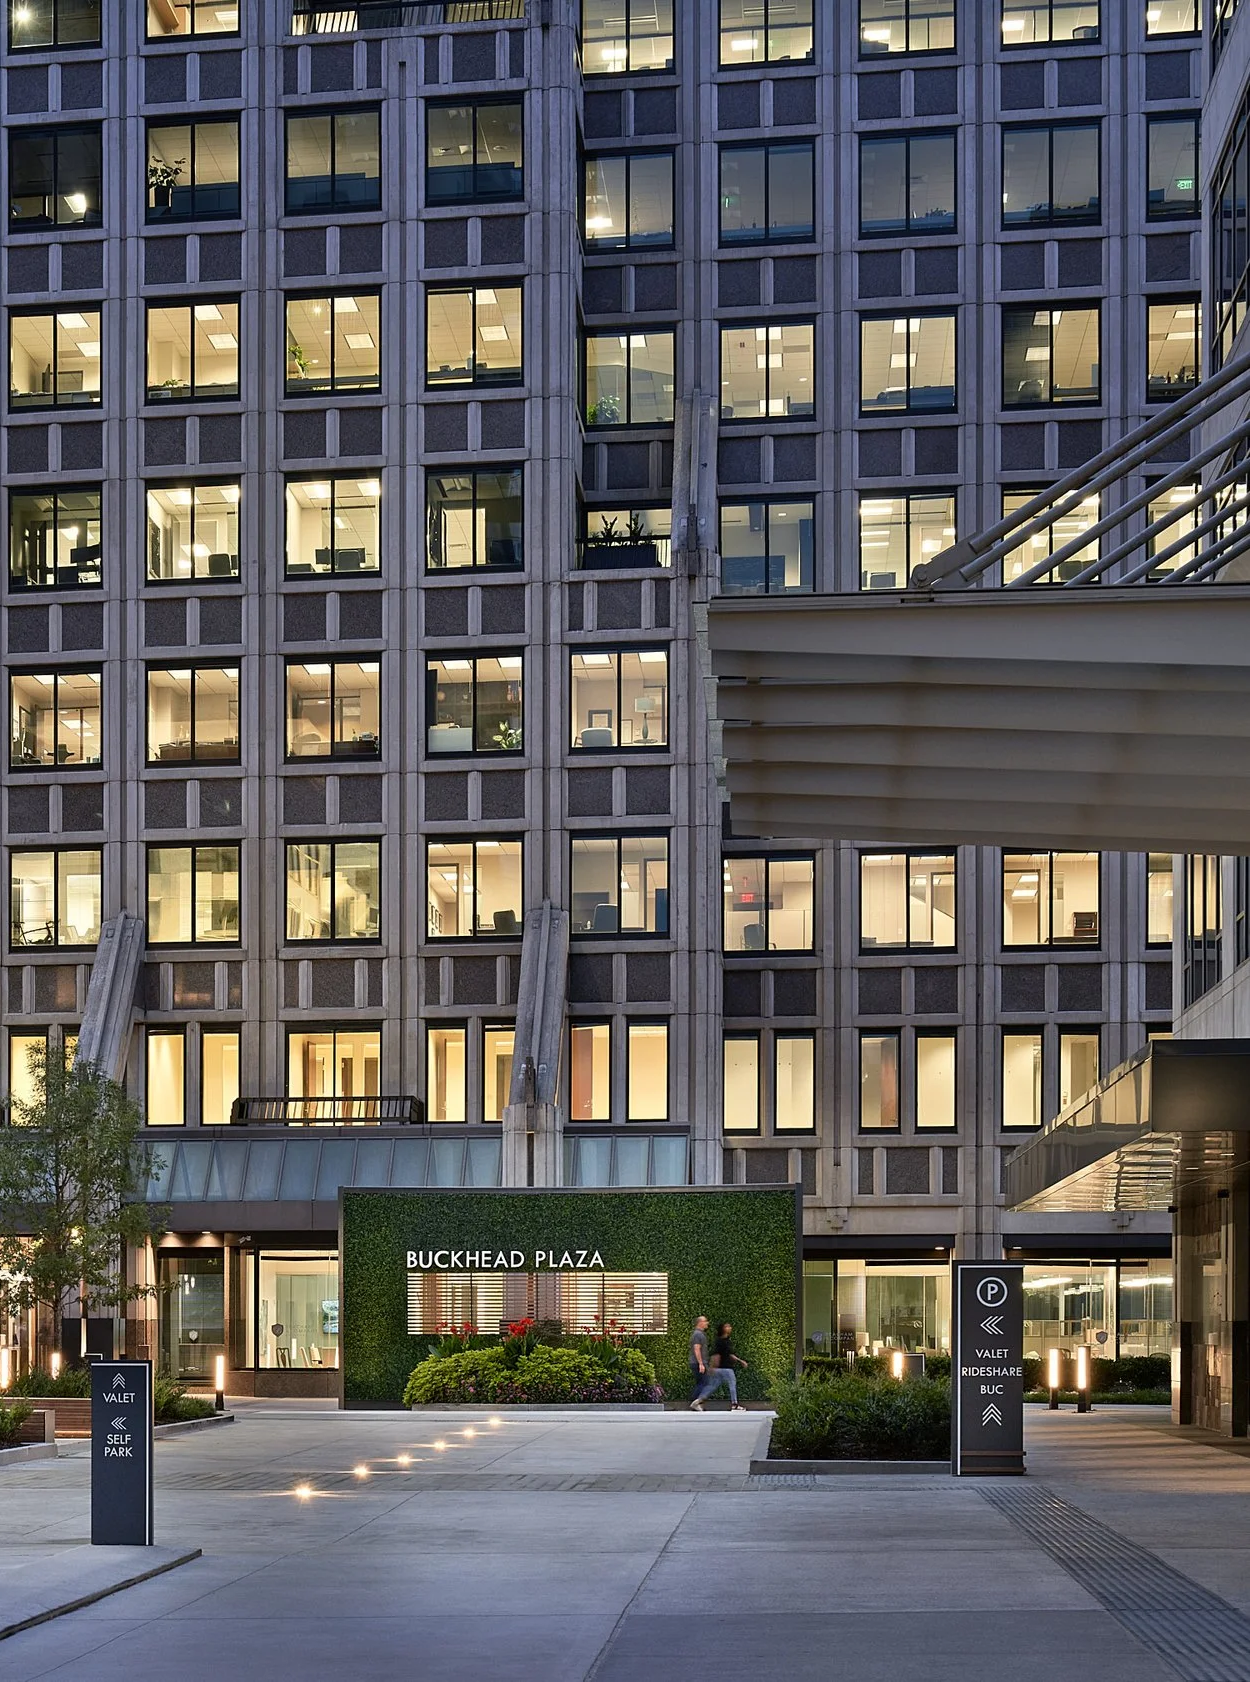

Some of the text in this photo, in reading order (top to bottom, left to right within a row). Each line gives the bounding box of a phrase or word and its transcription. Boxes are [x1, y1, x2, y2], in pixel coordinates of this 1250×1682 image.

[406, 1251, 605, 1269] BUCKHEAD PLAZA
[975, 1349, 1009, 1359] VALET
[961, 1367, 1023, 1377] RIDESHARE
[980, 1385, 1004, 1395] BUC
[103, 1393, 136, 1403] VALET
[107, 1434, 131, 1445] SELF
[104, 1447, 133, 1457] PARK
